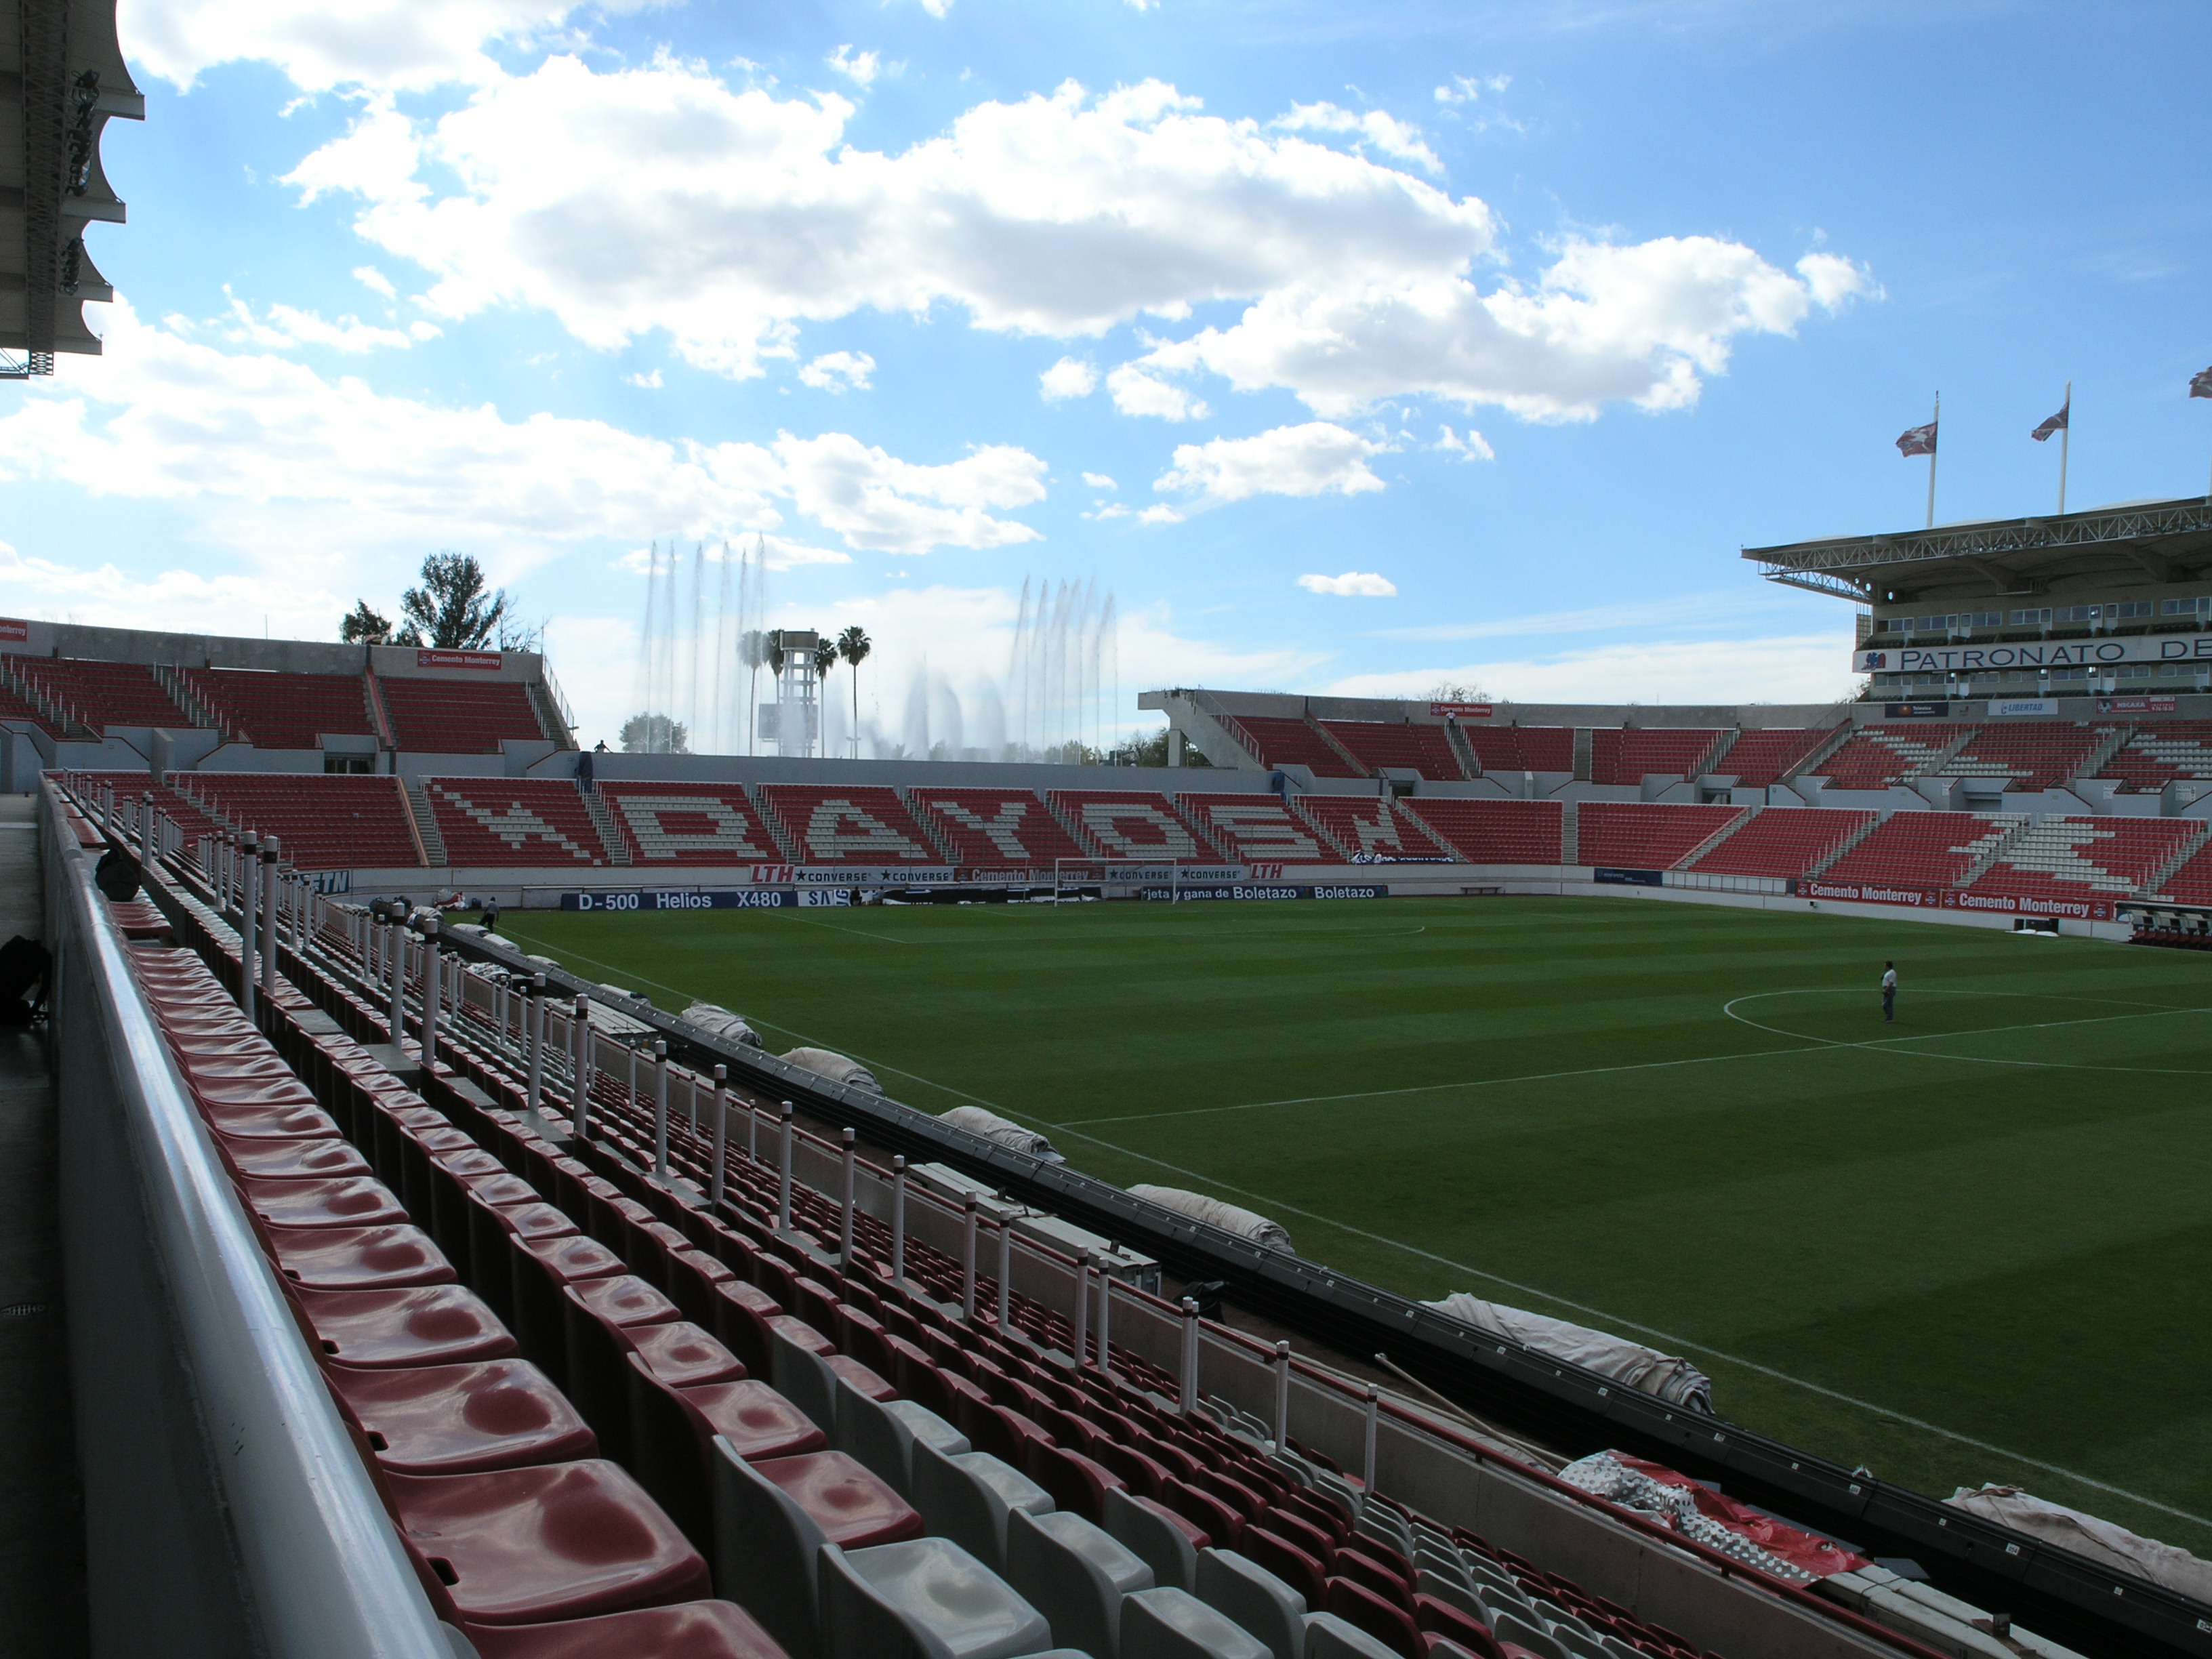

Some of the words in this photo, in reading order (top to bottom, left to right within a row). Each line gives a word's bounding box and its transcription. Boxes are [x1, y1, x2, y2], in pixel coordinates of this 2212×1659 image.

[432, 655, 463, 663] Cemento
[464, 656, 500, 665] Monterrey
[1900, 643, 2125, 670] PATRONATO
[2008, 703, 2043, 712] LIBERTAD
[751, 865, 795, 882] LTH
[808, 872, 867, 882] CONVERSE
[893, 872, 949, 881] CONVERSE
[972, 869, 1025, 882] Cemento
[1029, 869, 1089, 882] Monerrey
[1190, 870, 1237, 880] CONVERSE
[1251, 864, 1283, 879] LTH
[736, 891, 781, 907] X480
[1183, 889, 1212, 901] gana
[1215, 888, 1229, 899] de
[1233, 886, 1297, 900] Boletazo
[1315, 886, 1375, 899] Boletazo
[1810, 883, 1859, 899] Cemento
[1862, 886, 1922, 906] Monterrey
[579, 893, 639, 910] D-500
[656, 893, 712, 908] Helios
[1959, 893, 2016, 910] Cemento
[2019, 897, 2090, 918] Monterrey
